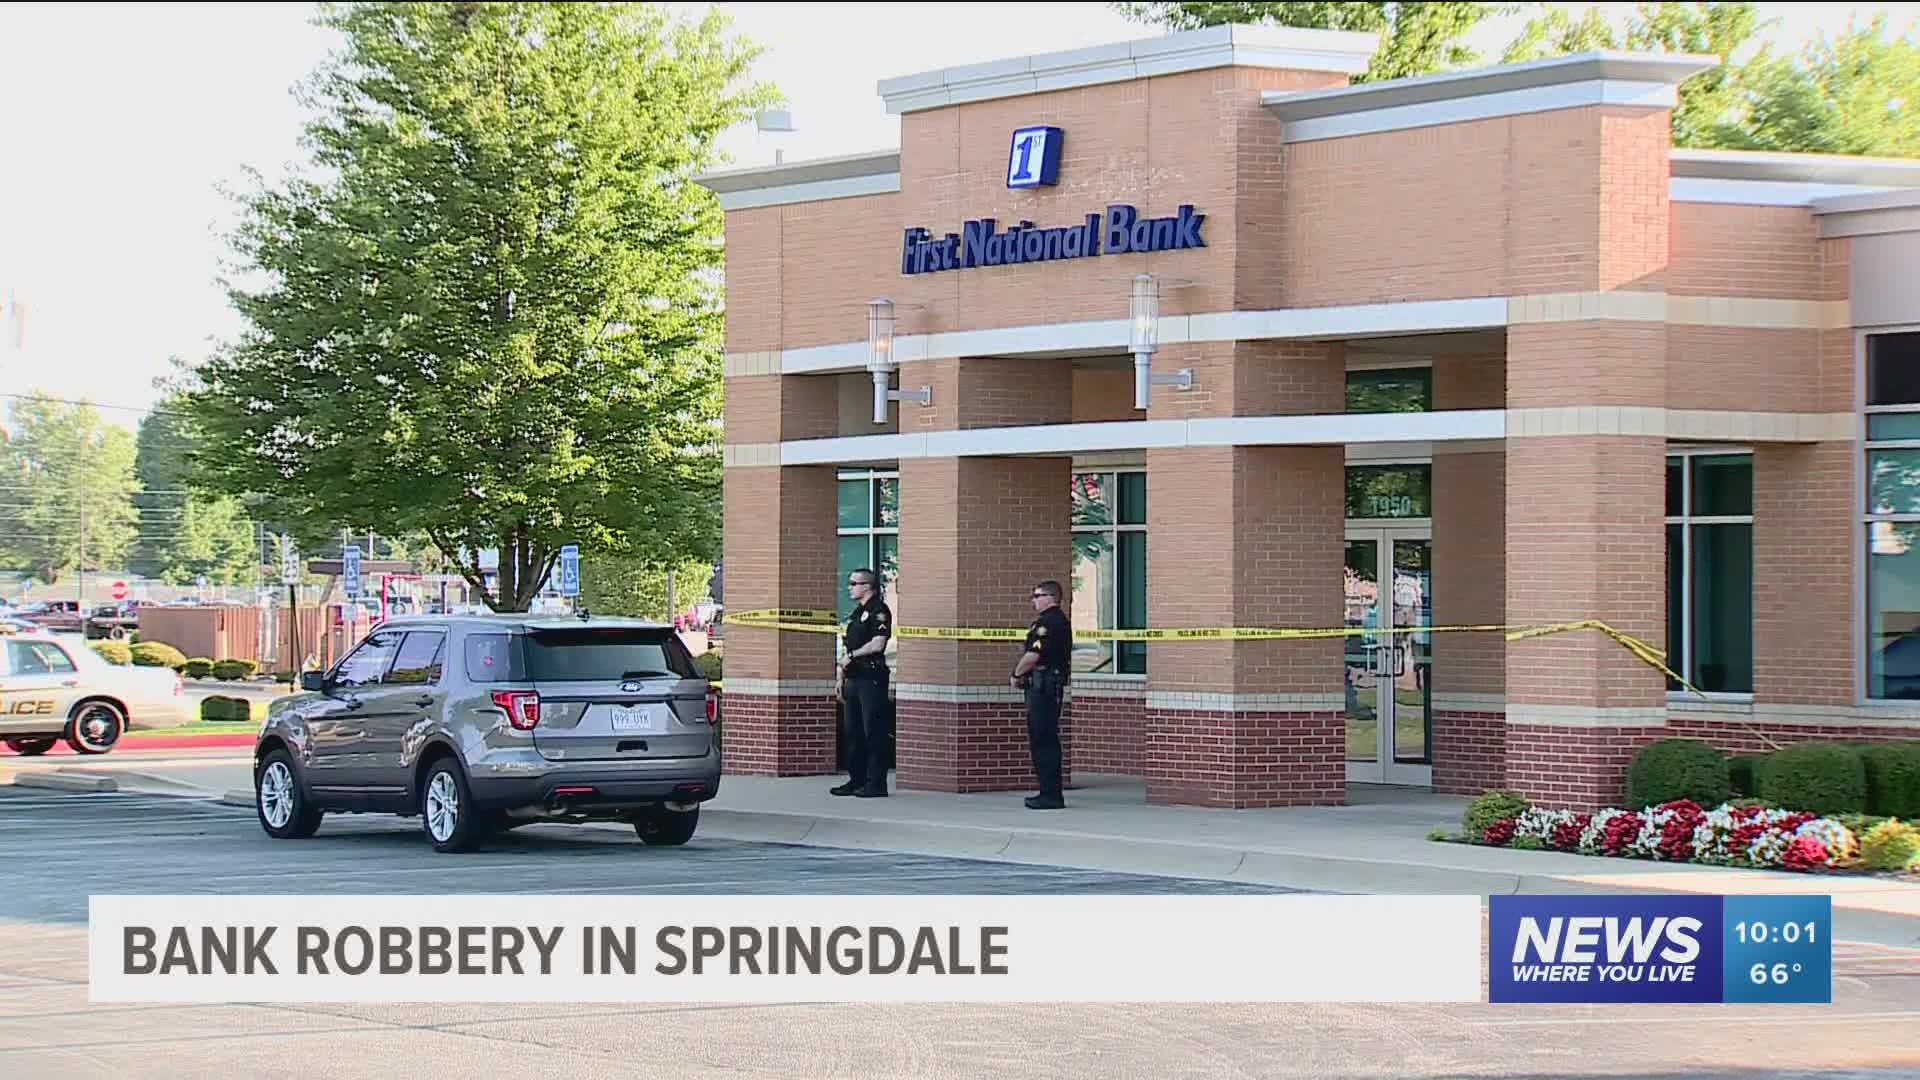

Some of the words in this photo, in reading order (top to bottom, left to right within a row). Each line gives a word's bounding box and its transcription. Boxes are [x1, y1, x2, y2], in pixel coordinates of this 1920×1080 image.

[902, 226, 961, 274] First
[960, 218, 1104, 268] National
[1104, 203, 1208, 255] Bank
[1368, 496, 1411, 516] 1950
